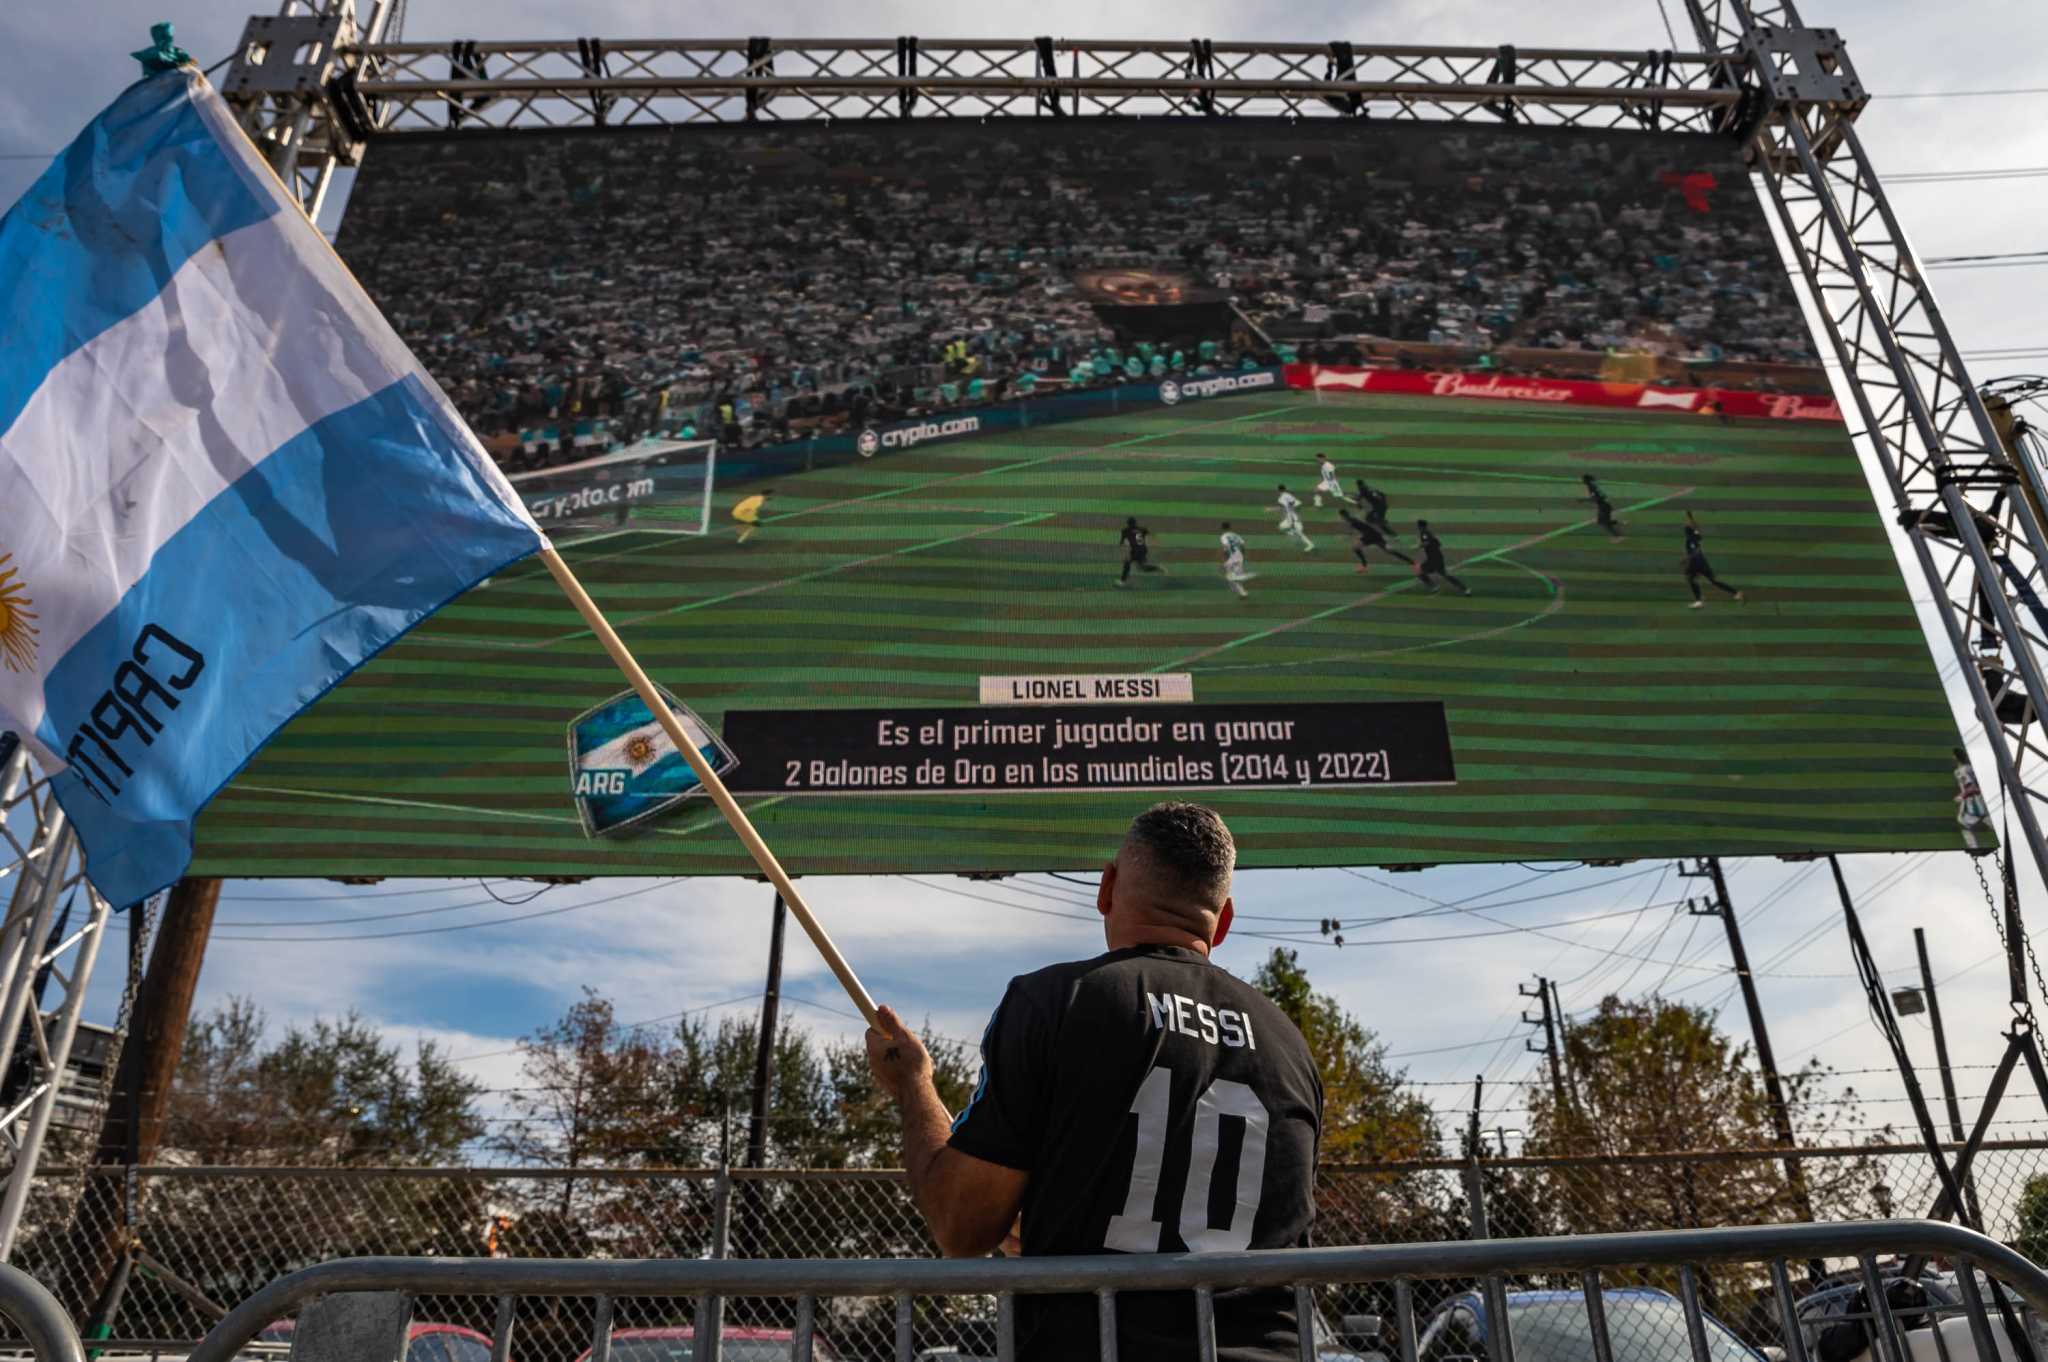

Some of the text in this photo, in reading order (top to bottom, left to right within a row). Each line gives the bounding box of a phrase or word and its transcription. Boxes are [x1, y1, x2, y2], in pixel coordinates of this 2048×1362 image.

[1182, 372, 1274, 397] crypto.com
[1425, 371, 1573, 401] Budweiser
[881, 416, 980, 447] crypto.com
[1013, 678, 1161, 699] LIONEL MESSI
[877, 717, 1295, 750] Es el primer jugador en ganar
[575, 771, 626, 795] ARG
[786, 761, 801, 786] 2
[809, 758, 908, 786] Balones
[915, 759, 946, 785] de
[954, 759, 997, 784] Oro
[1004, 763, 1035, 783] en
[1042, 757, 1079, 783] los
[1087, 754, 1214, 783] mundiales
[1296, 760, 1311, 786] y
[1146, 991, 1256, 1050] MESSI
[1103, 1066, 1270, 1253] 10
